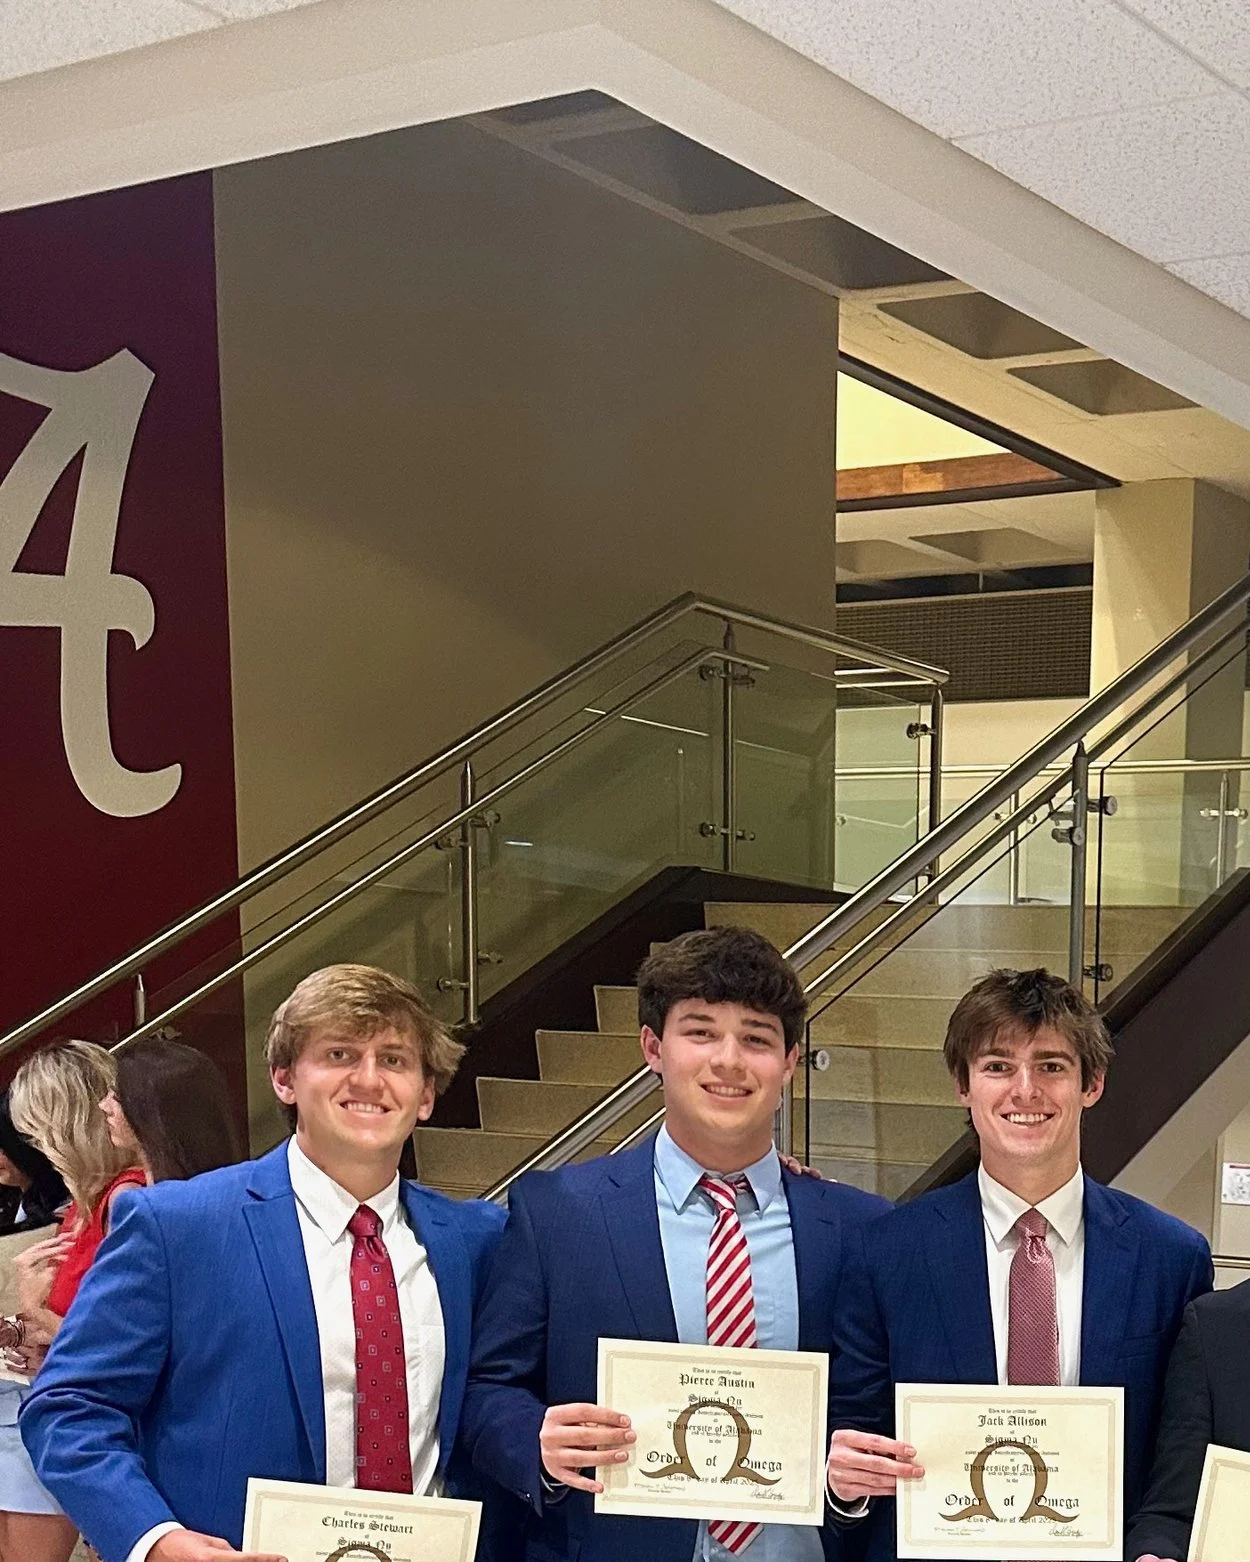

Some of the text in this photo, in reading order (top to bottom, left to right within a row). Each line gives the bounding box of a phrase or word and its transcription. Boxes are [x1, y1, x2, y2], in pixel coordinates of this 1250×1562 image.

[679, 1373, 755, 1389] Pierce Austin
[714, 1425, 722, 1433] of
[977, 1415, 1047, 1427] Jack Allison
[646, 1450, 782, 1472] Order of Omega
[1011, 1464, 1019, 1472] of
[945, 1493, 1080, 1509] Order of Omega
[322, 1515, 365, 1530] Charles
[368, 1520, 414, 1534] Stewart
